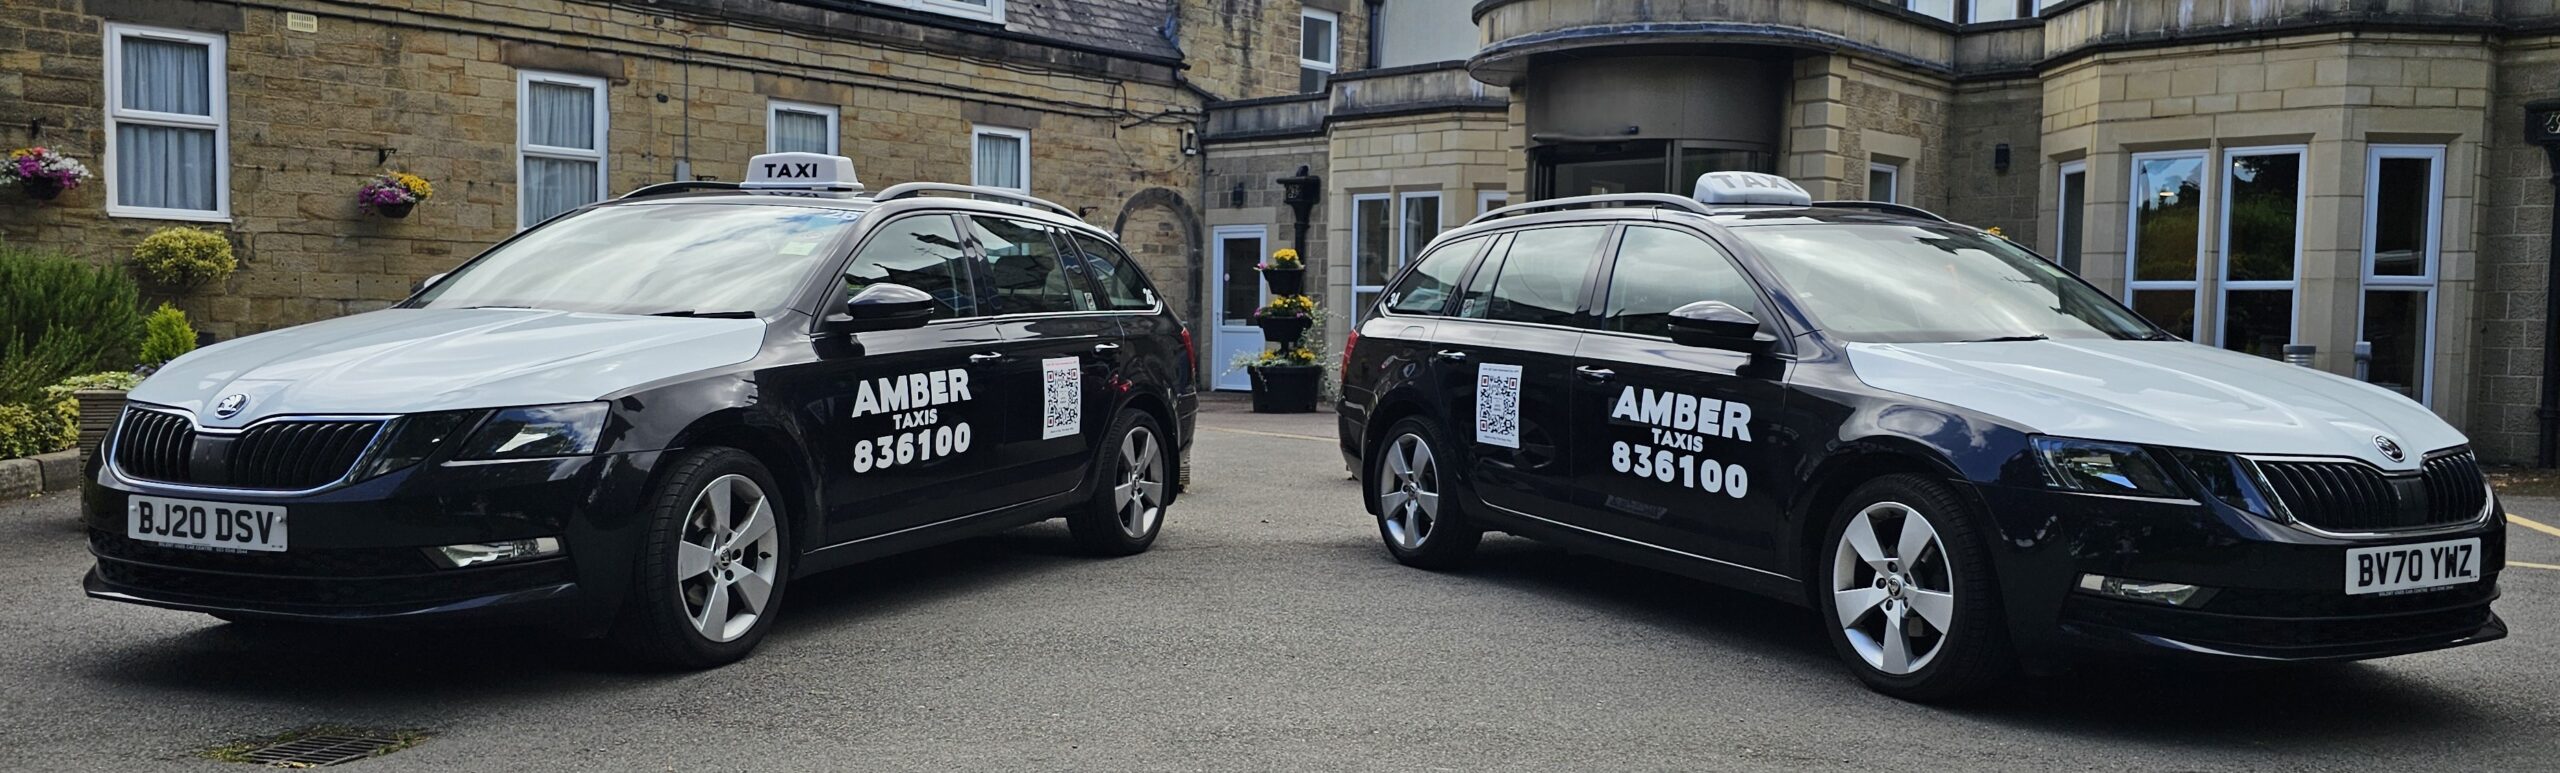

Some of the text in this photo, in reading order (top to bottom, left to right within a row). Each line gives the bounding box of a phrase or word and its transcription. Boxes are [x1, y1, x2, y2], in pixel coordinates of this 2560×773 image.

[765, 163, 817, 178] TAXI
[1710, 174, 1802, 192] TAXI
[1142, 287, 1156, 305] 26
[1387, 291, 1401, 308] 34
[852, 368, 972, 418] AMBER
[893, 408, 938, 430] TAXIS
[1612, 386, 1752, 442] AMBER
[853, 422, 971, 473] 836100
[1652, 428, 1703, 452] TAXIS
[1612, 441, 1748, 499] 836100
[139, 501, 274, 544] BJ20 DSV
[2358, 544, 2472, 587] BV70 YWZ
